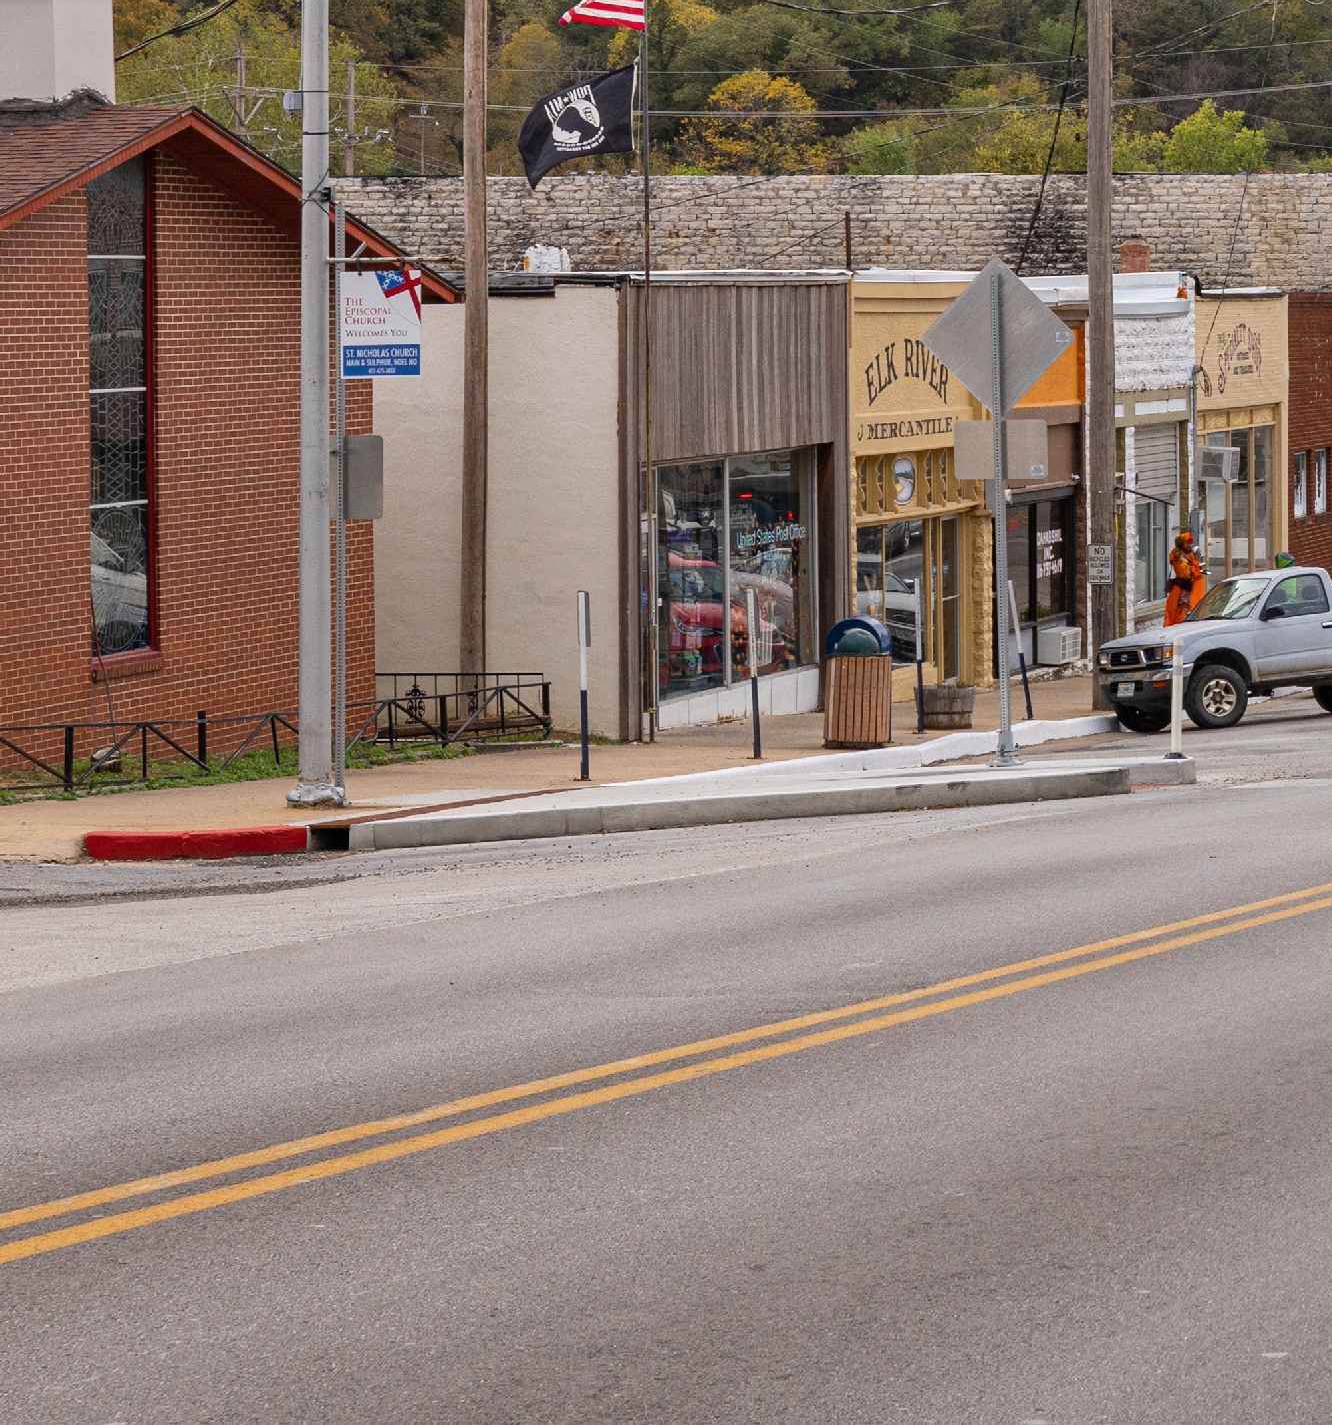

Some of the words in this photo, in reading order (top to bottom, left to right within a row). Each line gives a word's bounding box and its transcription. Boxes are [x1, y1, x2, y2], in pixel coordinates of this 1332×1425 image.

[345, 297, 364, 306] THE
[345, 307, 392, 316] EPISCOPAL
[345, 317, 386, 325] CHURCH
[345, 330, 388, 338] WELCOMES
[391, 329, 408, 337] YOU
[357, 348, 390, 358] NICHOLAS
[391, 347, 418, 357] CHURCH
[394, 358, 408, 366] NOEL
[409, 358, 418, 366] MO
[865, 342, 898, 407] ELK
[904, 338, 948, 405] RIVER
[867, 416, 953, 441] MERCANTILE
[736, 529, 756, 549] United
[757, 527, 775, 545] States
[776, 525, 789, 542] Post
[789, 523, 806, 541] Office
[1094, 547, 1106, 556] NO
